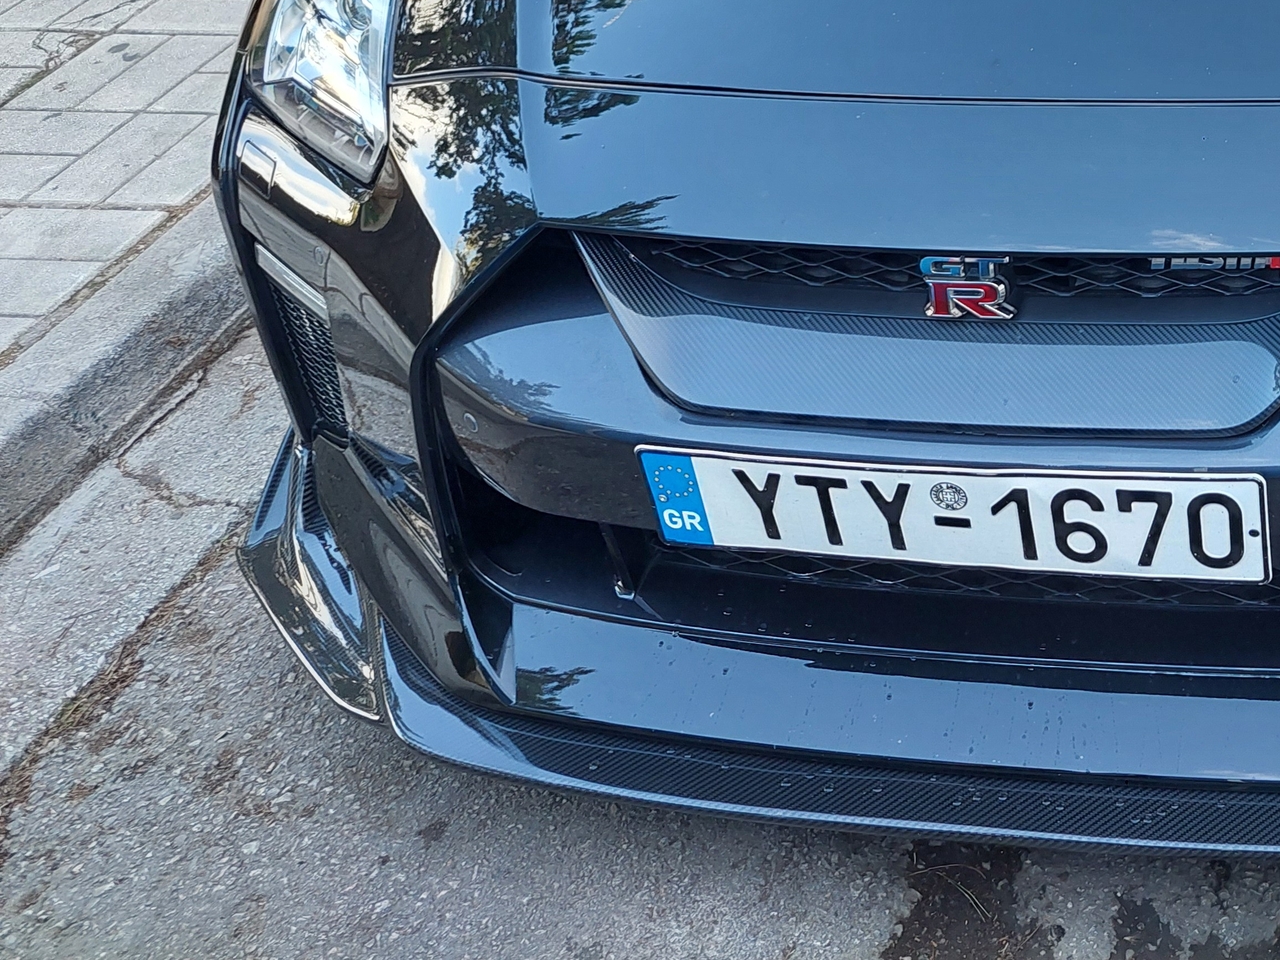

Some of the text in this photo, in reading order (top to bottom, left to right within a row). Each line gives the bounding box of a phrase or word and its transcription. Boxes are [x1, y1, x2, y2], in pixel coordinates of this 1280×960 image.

[920, 255, 1010, 280] GT
[924, 279, 1015, 319] R
[662, 508, 705, 532] GR
[732, 468, 1243, 570] YTY-1670
